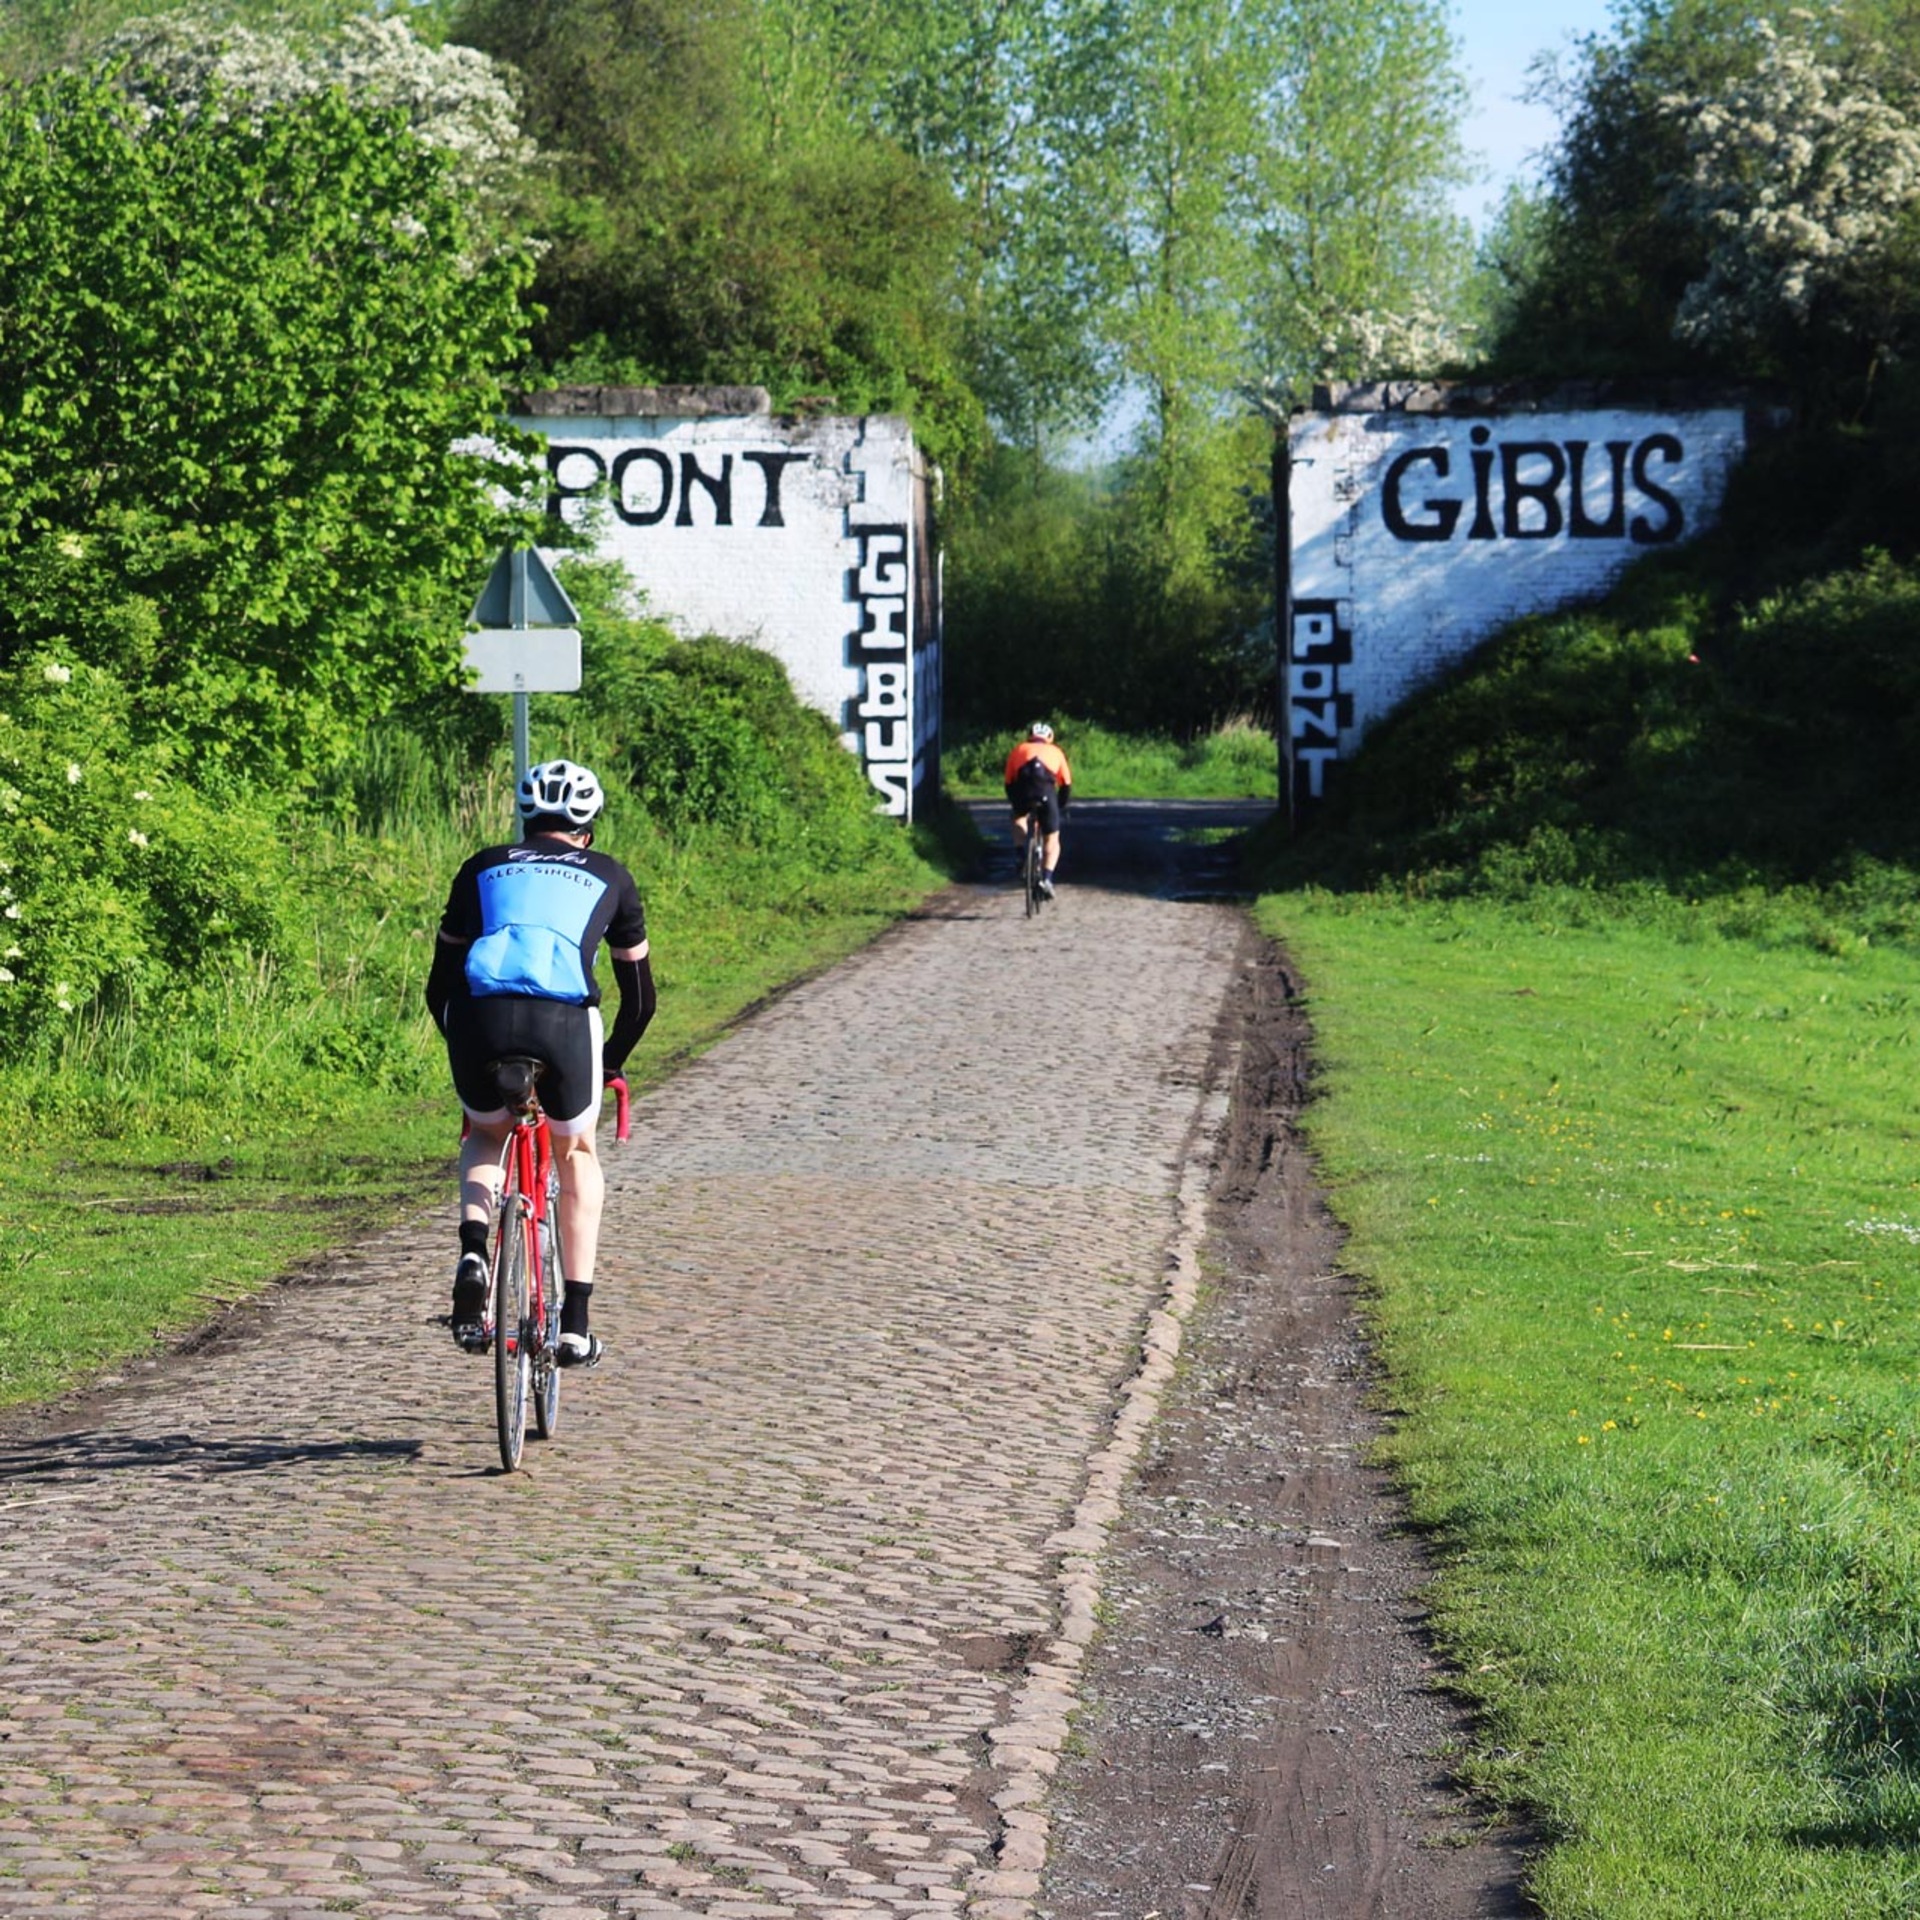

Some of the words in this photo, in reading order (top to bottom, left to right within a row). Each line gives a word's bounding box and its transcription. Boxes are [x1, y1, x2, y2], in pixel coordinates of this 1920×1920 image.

[546, 446, 812, 527] PONT
[858, 534, 907, 816] GIBUS
[1290, 613, 1338, 797] PONT
[486, 867, 526, 882] ALEX
